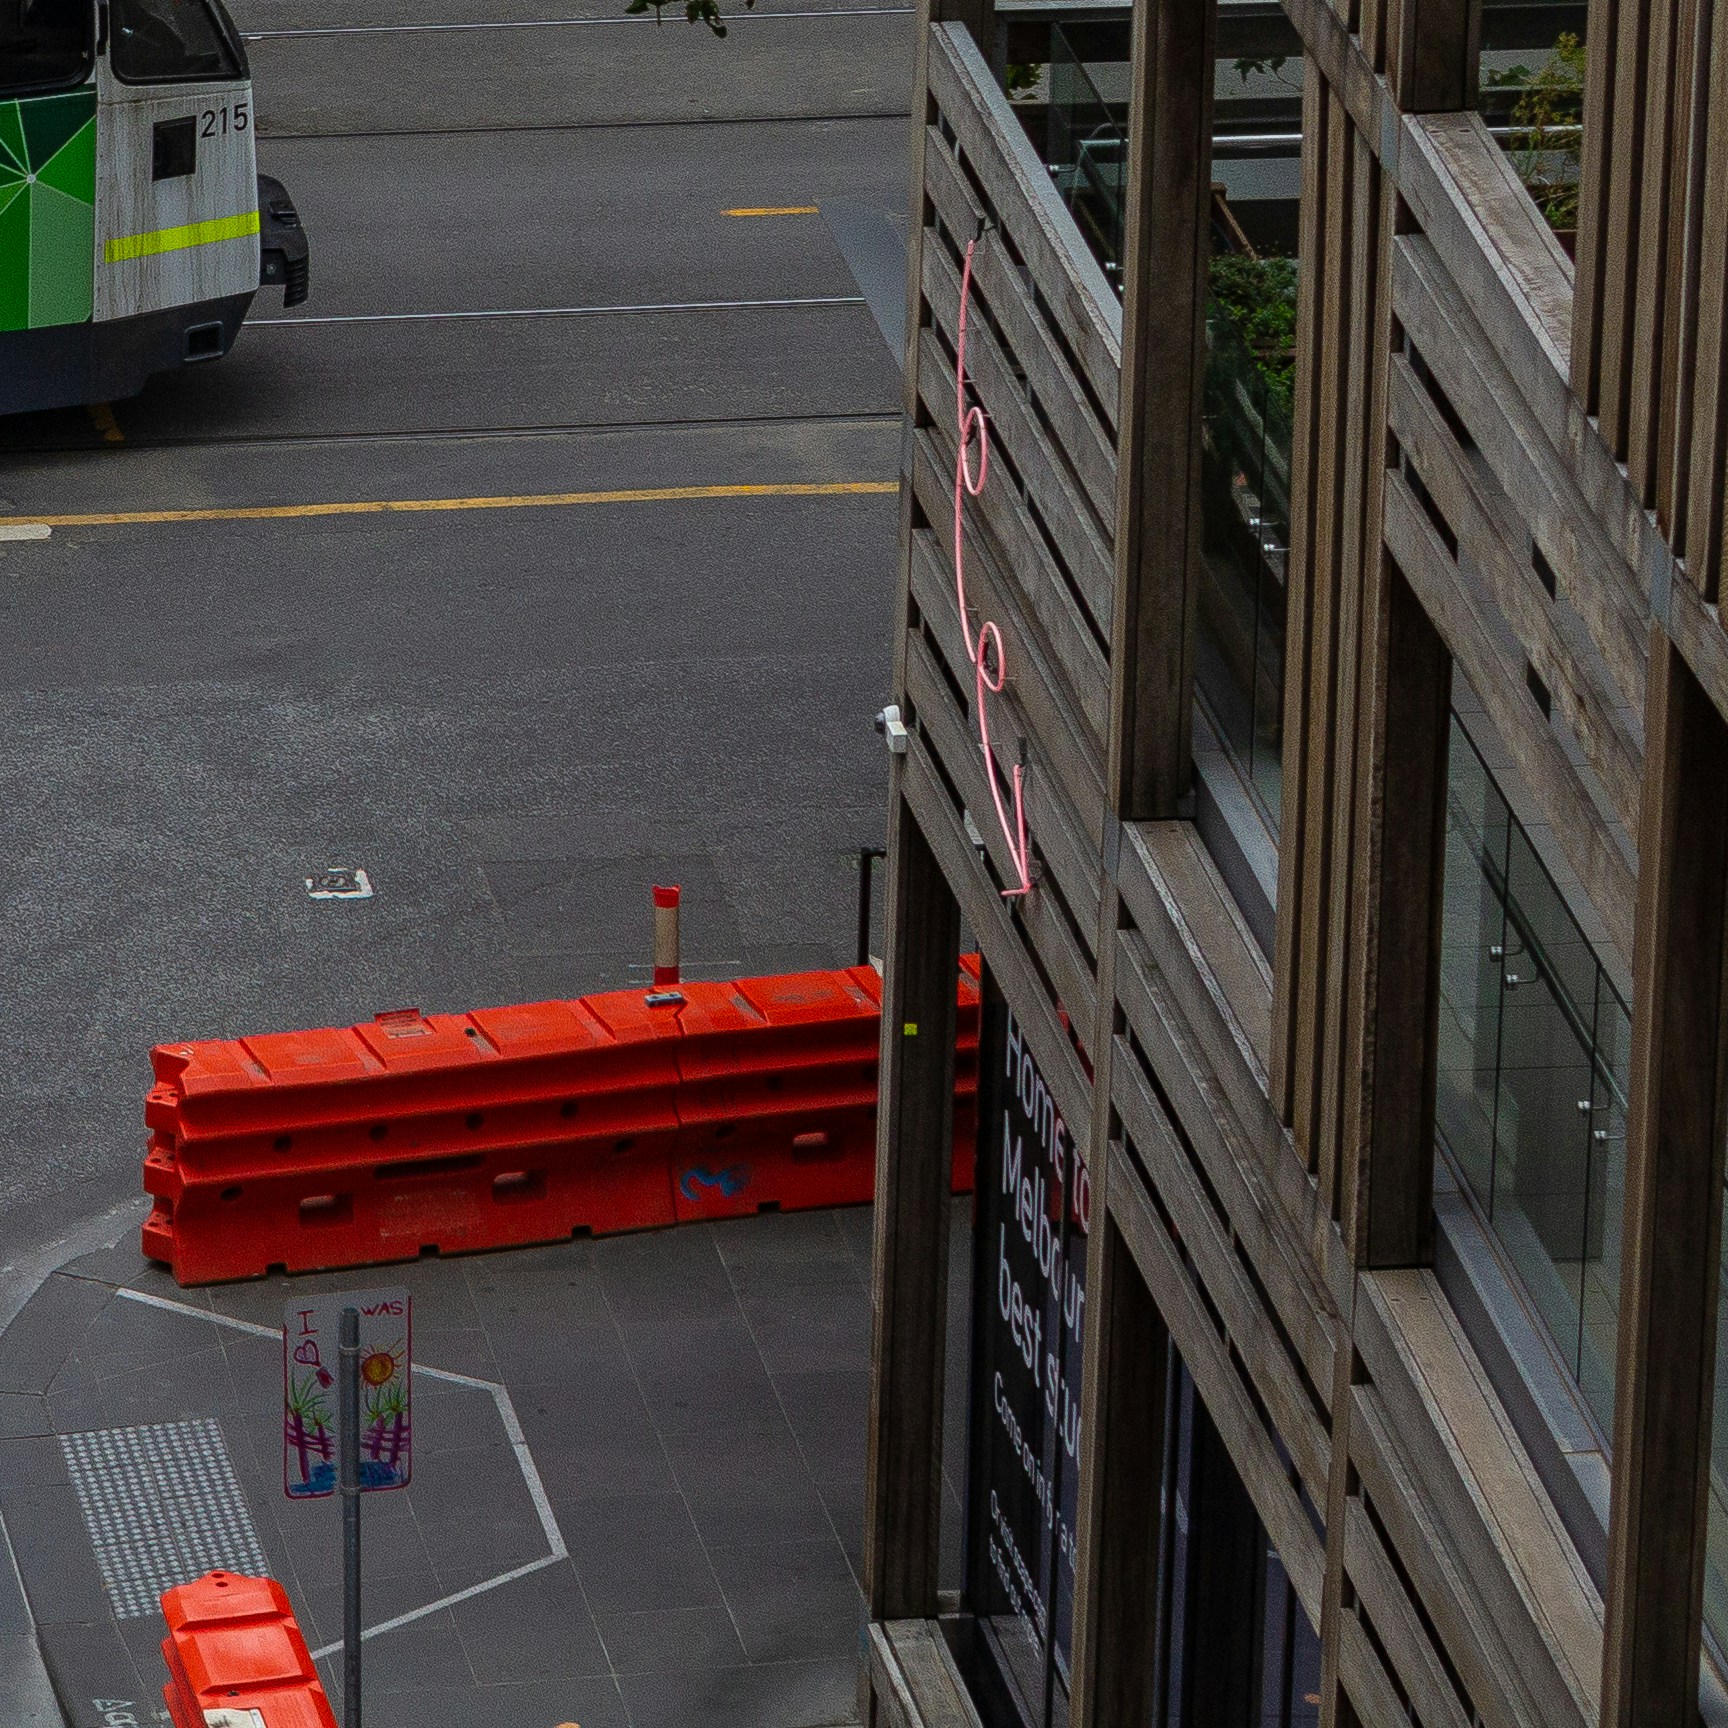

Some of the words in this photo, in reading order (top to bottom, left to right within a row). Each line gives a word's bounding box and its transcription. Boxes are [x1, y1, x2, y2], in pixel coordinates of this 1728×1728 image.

[200, 104, 248, 140] 215
[1006, 1006, 1065, 1184] Home
[361, 1300, 405, 1317] WAS
[998, 1221, 1041, 1388] best
[994, 1371, 1022, 1456] Come
